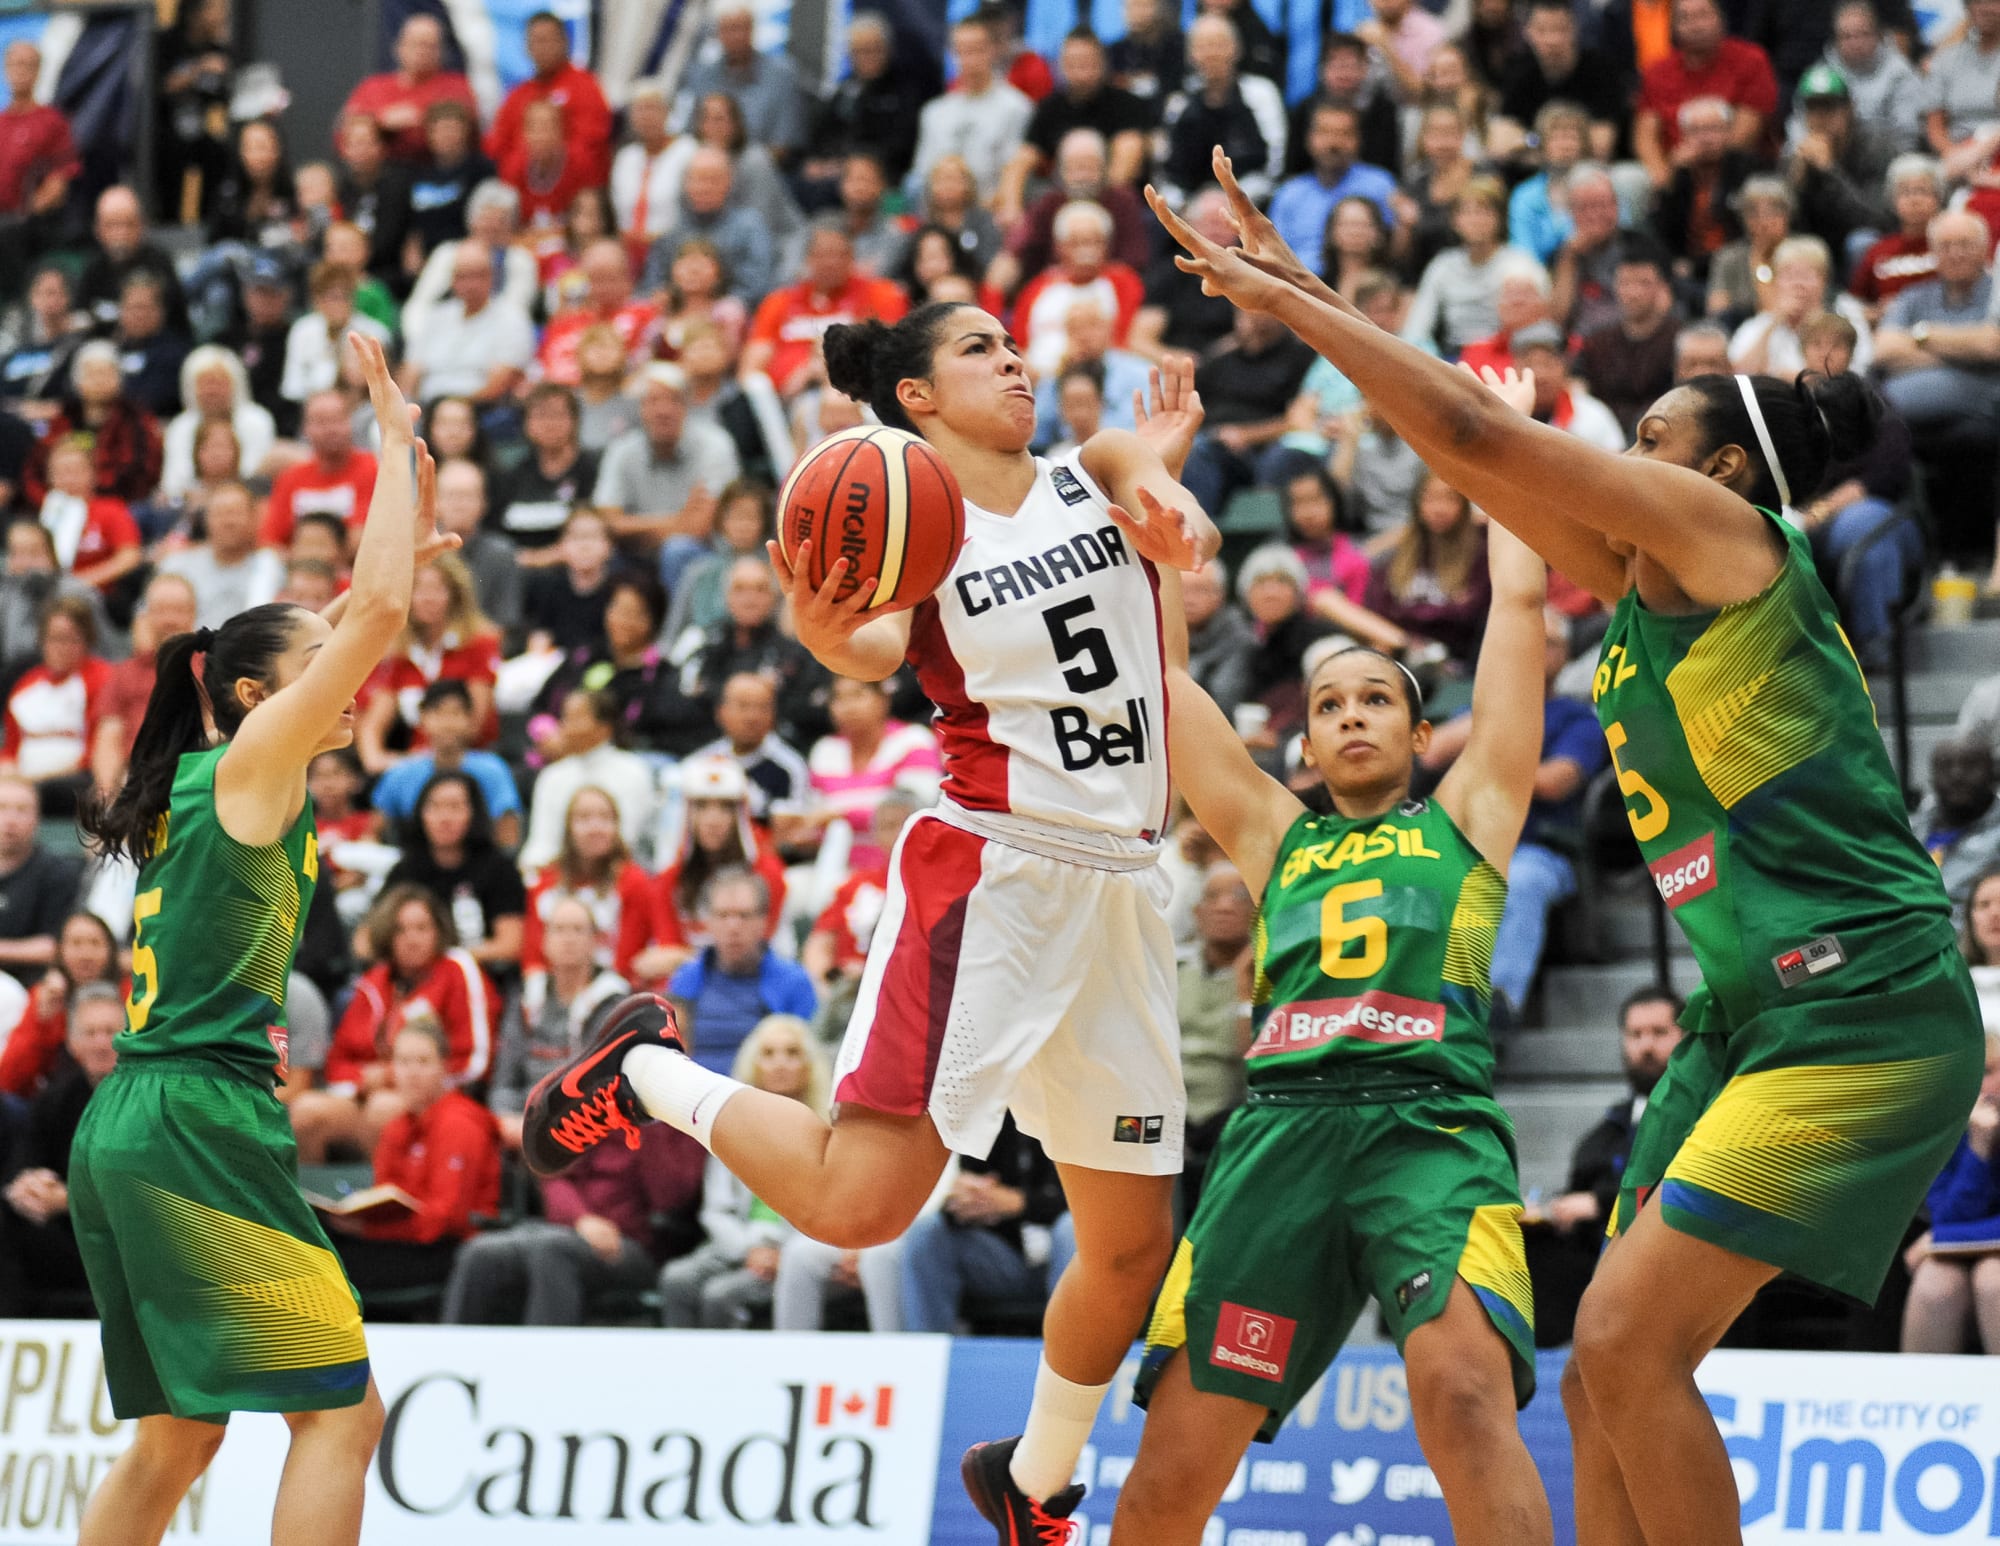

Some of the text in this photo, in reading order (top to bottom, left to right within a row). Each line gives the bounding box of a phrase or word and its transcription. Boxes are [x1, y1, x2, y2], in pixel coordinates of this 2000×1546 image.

[839, 482, 870, 592] molten
[955, 525, 1130, 618] CANADA
[1042, 594, 1119, 694] 5
[1605, 721, 1670, 842] 5
[1280, 824, 1441, 890] BRASIL
[1319, 878, 1388, 980] 6
[1289, 1001, 1436, 1042] Bradesco
[1215, 1345, 1280, 1376] Bradesco
[1335, 1363, 1411, 1432] US
[377, 1368, 887, 1531] Canada
[1797, 1401, 1981, 1431] THE CITY OF
[1700, 1392, 2000, 1538] dmo
